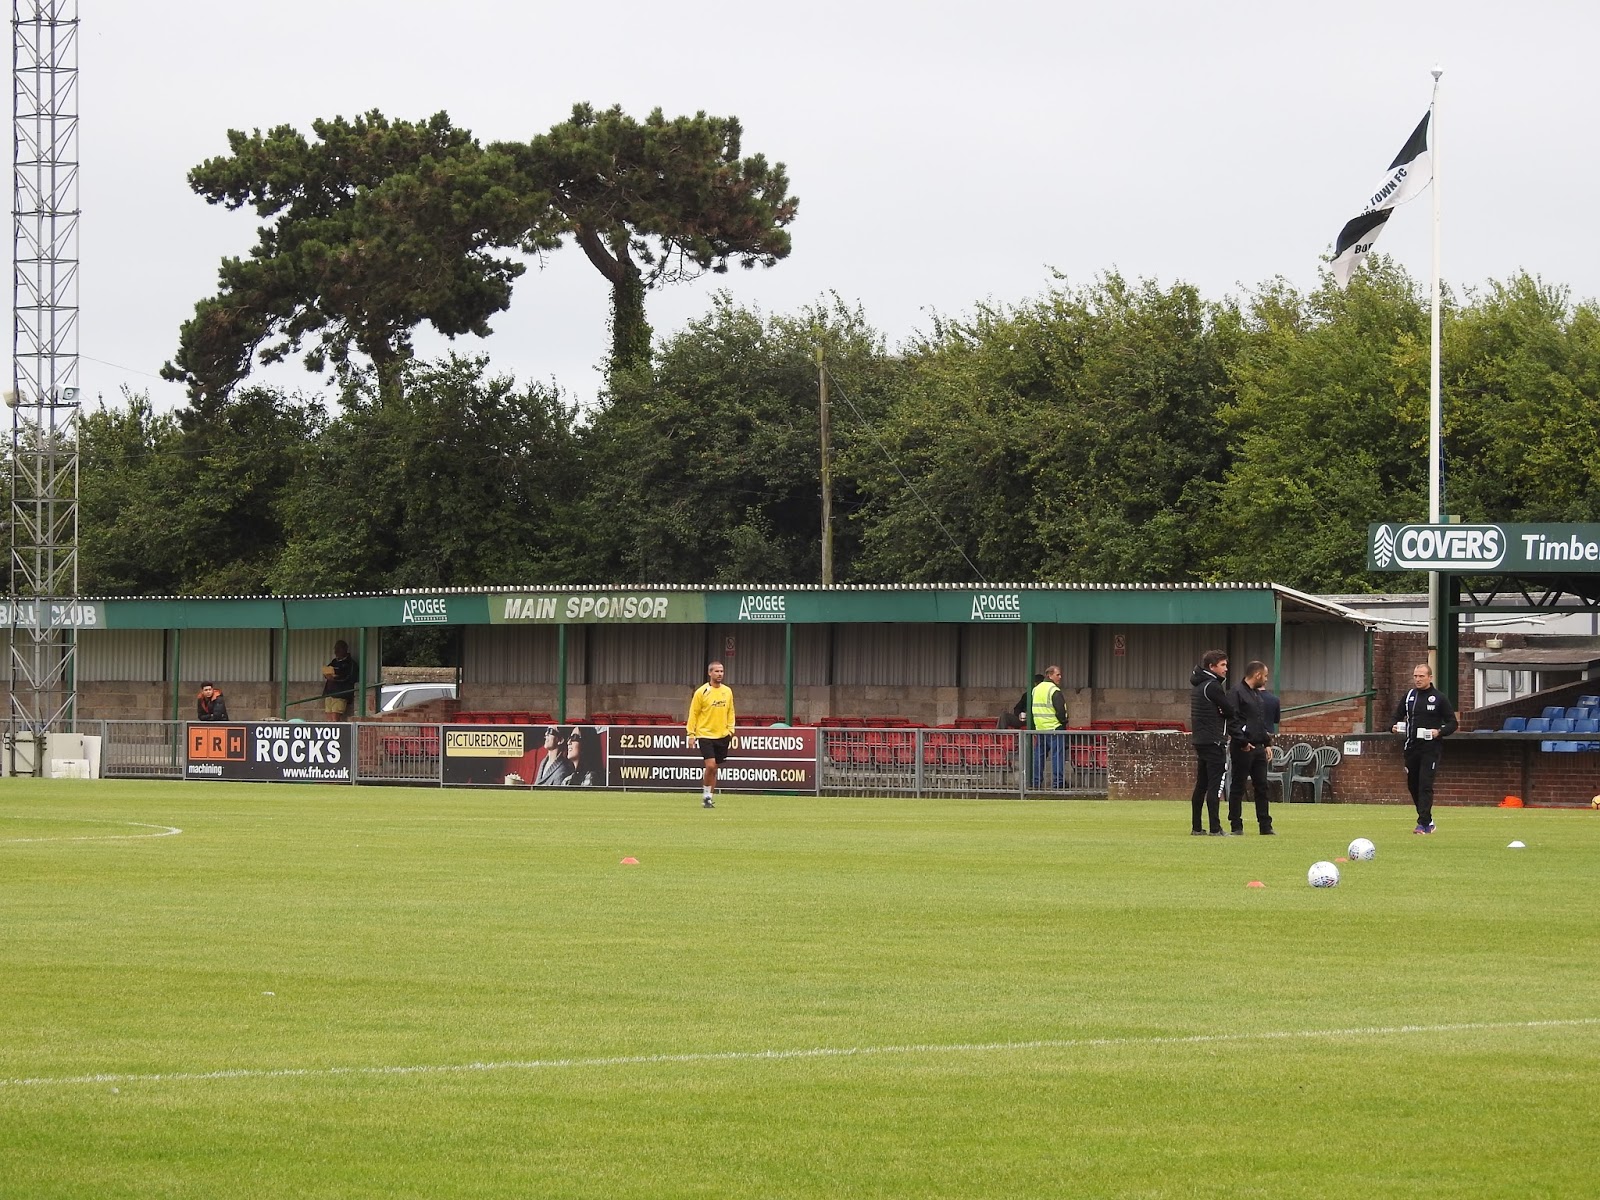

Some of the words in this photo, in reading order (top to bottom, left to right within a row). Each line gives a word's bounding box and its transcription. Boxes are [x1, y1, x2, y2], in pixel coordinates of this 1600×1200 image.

[1370, 180, 1398, 206] TOWN
[1394, 168, 1407, 183] FC
[1401, 530, 1499, 559] COVERS
[1521, 534, 1600, 561] Timbe
[51, 605, 97, 626] CLUB
[402, 598, 447, 623] APOGEE
[504, 598, 557, 619] MAIN
[565, 597, 668, 619] SPONSOR
[738, 595, 786, 620] APOGEE
[971, 594, 1020, 620] APOGEE
[255, 726, 290, 739] COME
[294, 727, 311, 739] ON
[315, 727, 340, 740] YOU
[447, 733, 523, 747] PICTUREDROME
[620, 734, 651, 748] £2.50
[740, 736, 804, 750] WEEKENDS
[256, 740, 341, 763] ROCKS
[188, 763, 223, 776] machining
[283, 766, 349, 779] www.frh.co.uk
[620, 766, 806, 782] WWW.PICTUREDMEBOGNOR.COM
